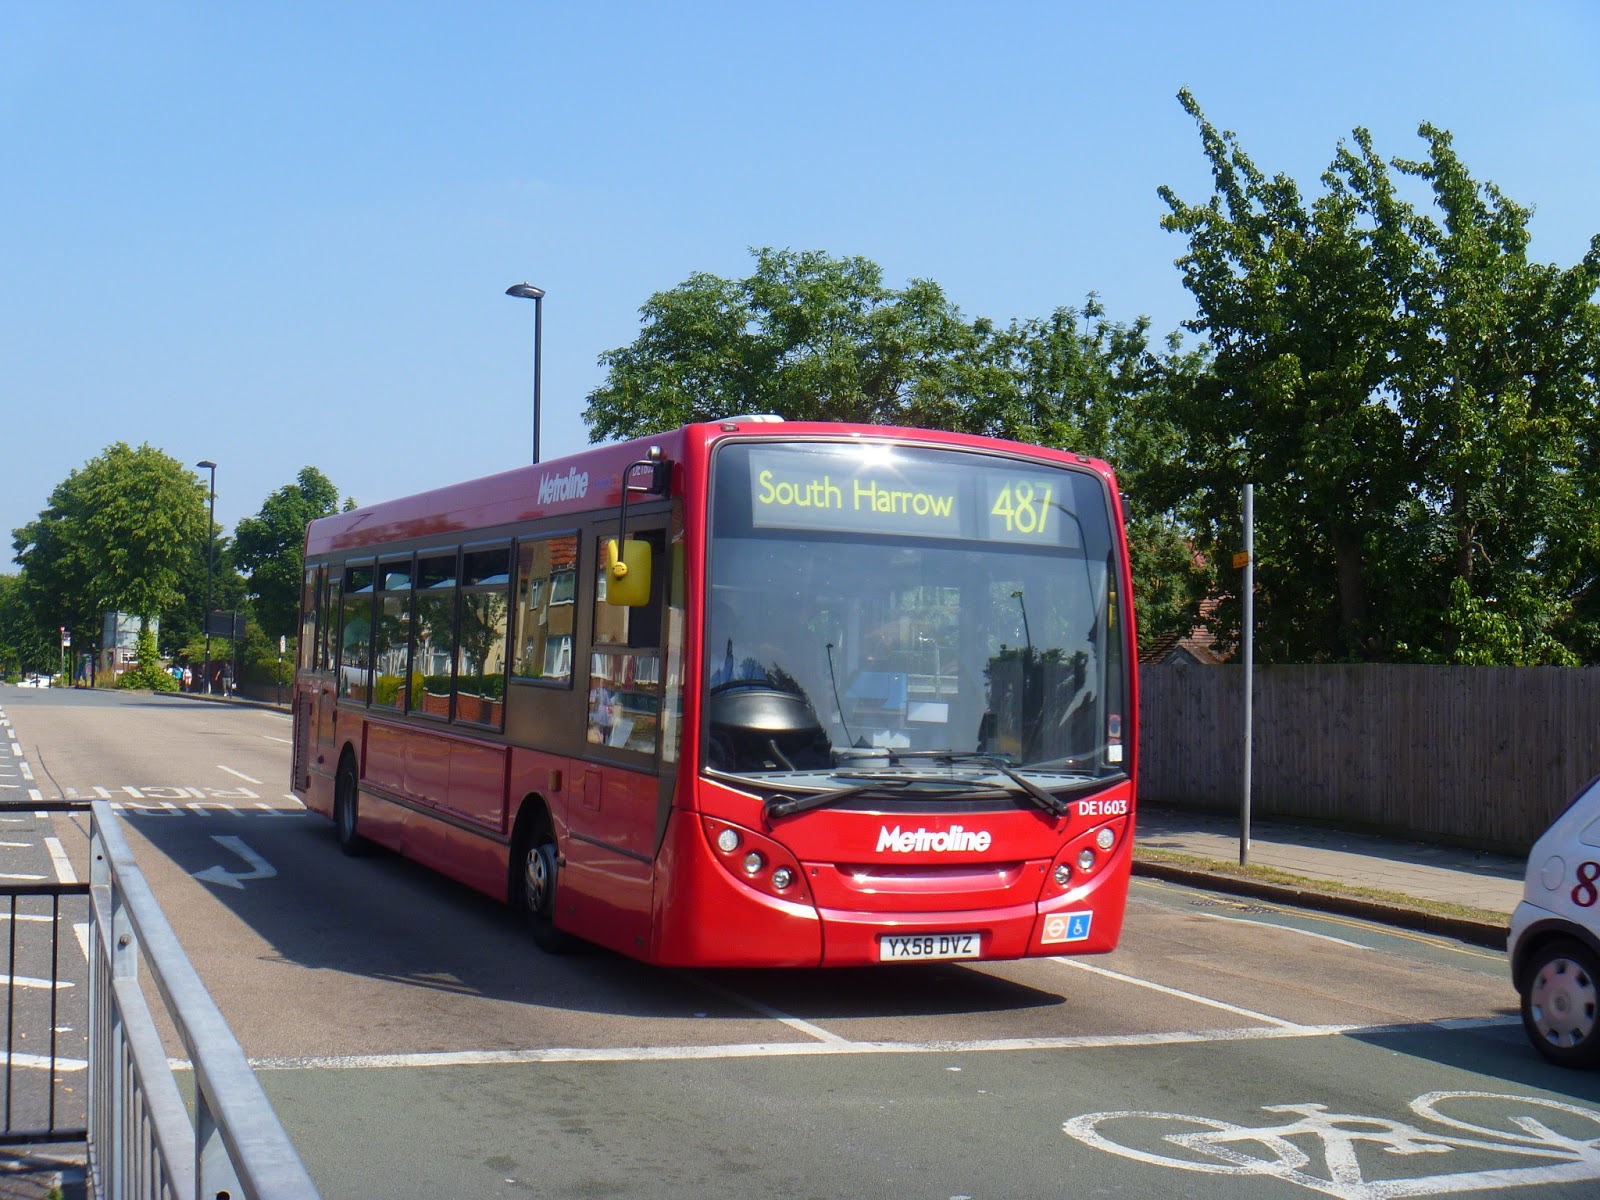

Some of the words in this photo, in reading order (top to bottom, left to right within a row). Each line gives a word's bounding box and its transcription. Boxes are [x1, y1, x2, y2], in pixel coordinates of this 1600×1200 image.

[537, 466, 589, 505] Metroline
[758, 470, 842, 510] South
[853, 478, 954, 517] Harrow
[991, 480, 1053, 533] 487
[1078, 800, 1127, 816] DE1603
[876, 825, 992, 852] Metroline
[888, 937, 934, 956] YX58
[938, 935, 973, 954] DVZ
